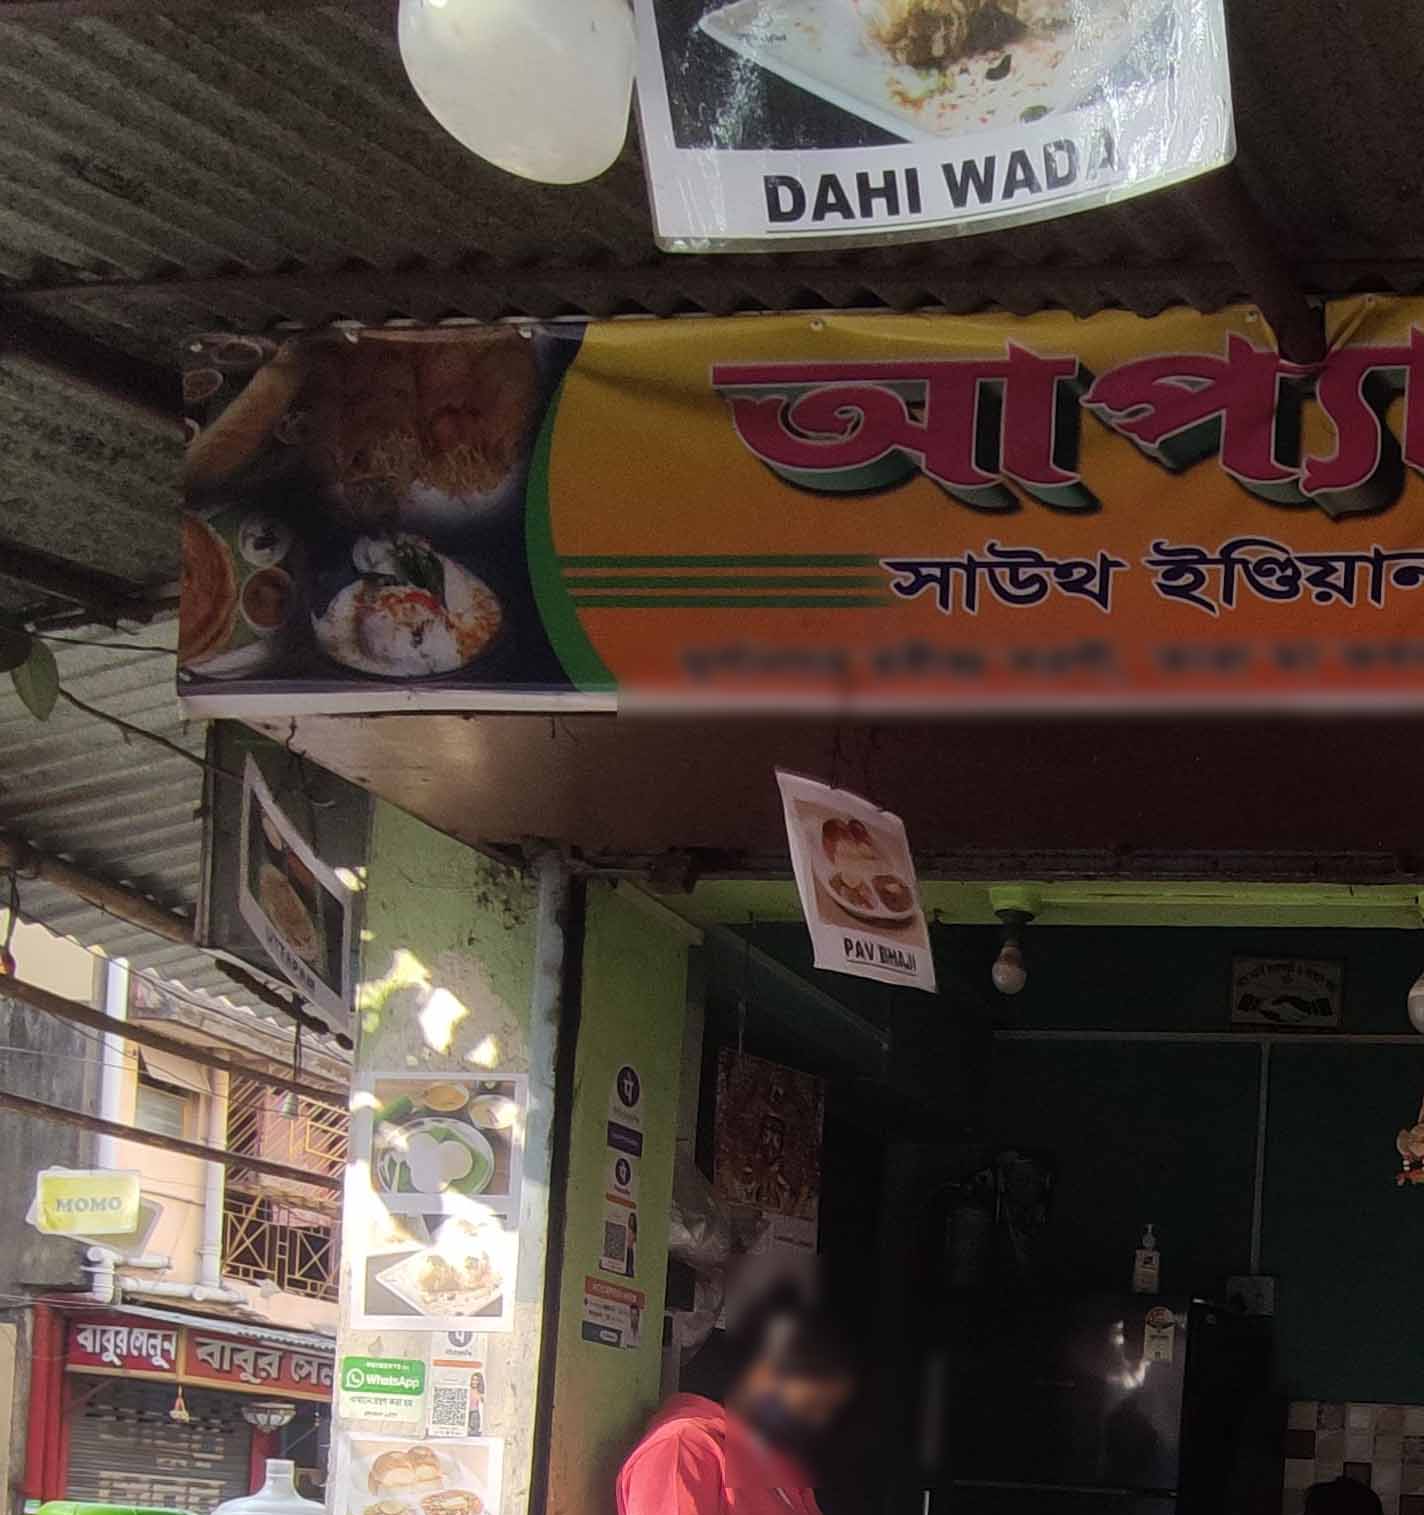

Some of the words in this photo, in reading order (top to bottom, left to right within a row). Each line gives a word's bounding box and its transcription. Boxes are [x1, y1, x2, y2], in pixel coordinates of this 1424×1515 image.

[763, 166, 922, 224] DAHI
[880, 543, 1130, 616] সাউথ
[844, 937, 874, 960] PAV
[55, 1196, 123, 1213] MOMO
[77, 1324, 128, 1365] বাবুর
[195, 1337, 283, 1384] বাবুর
[366, 1374, 420, 1389] WhatsApp
